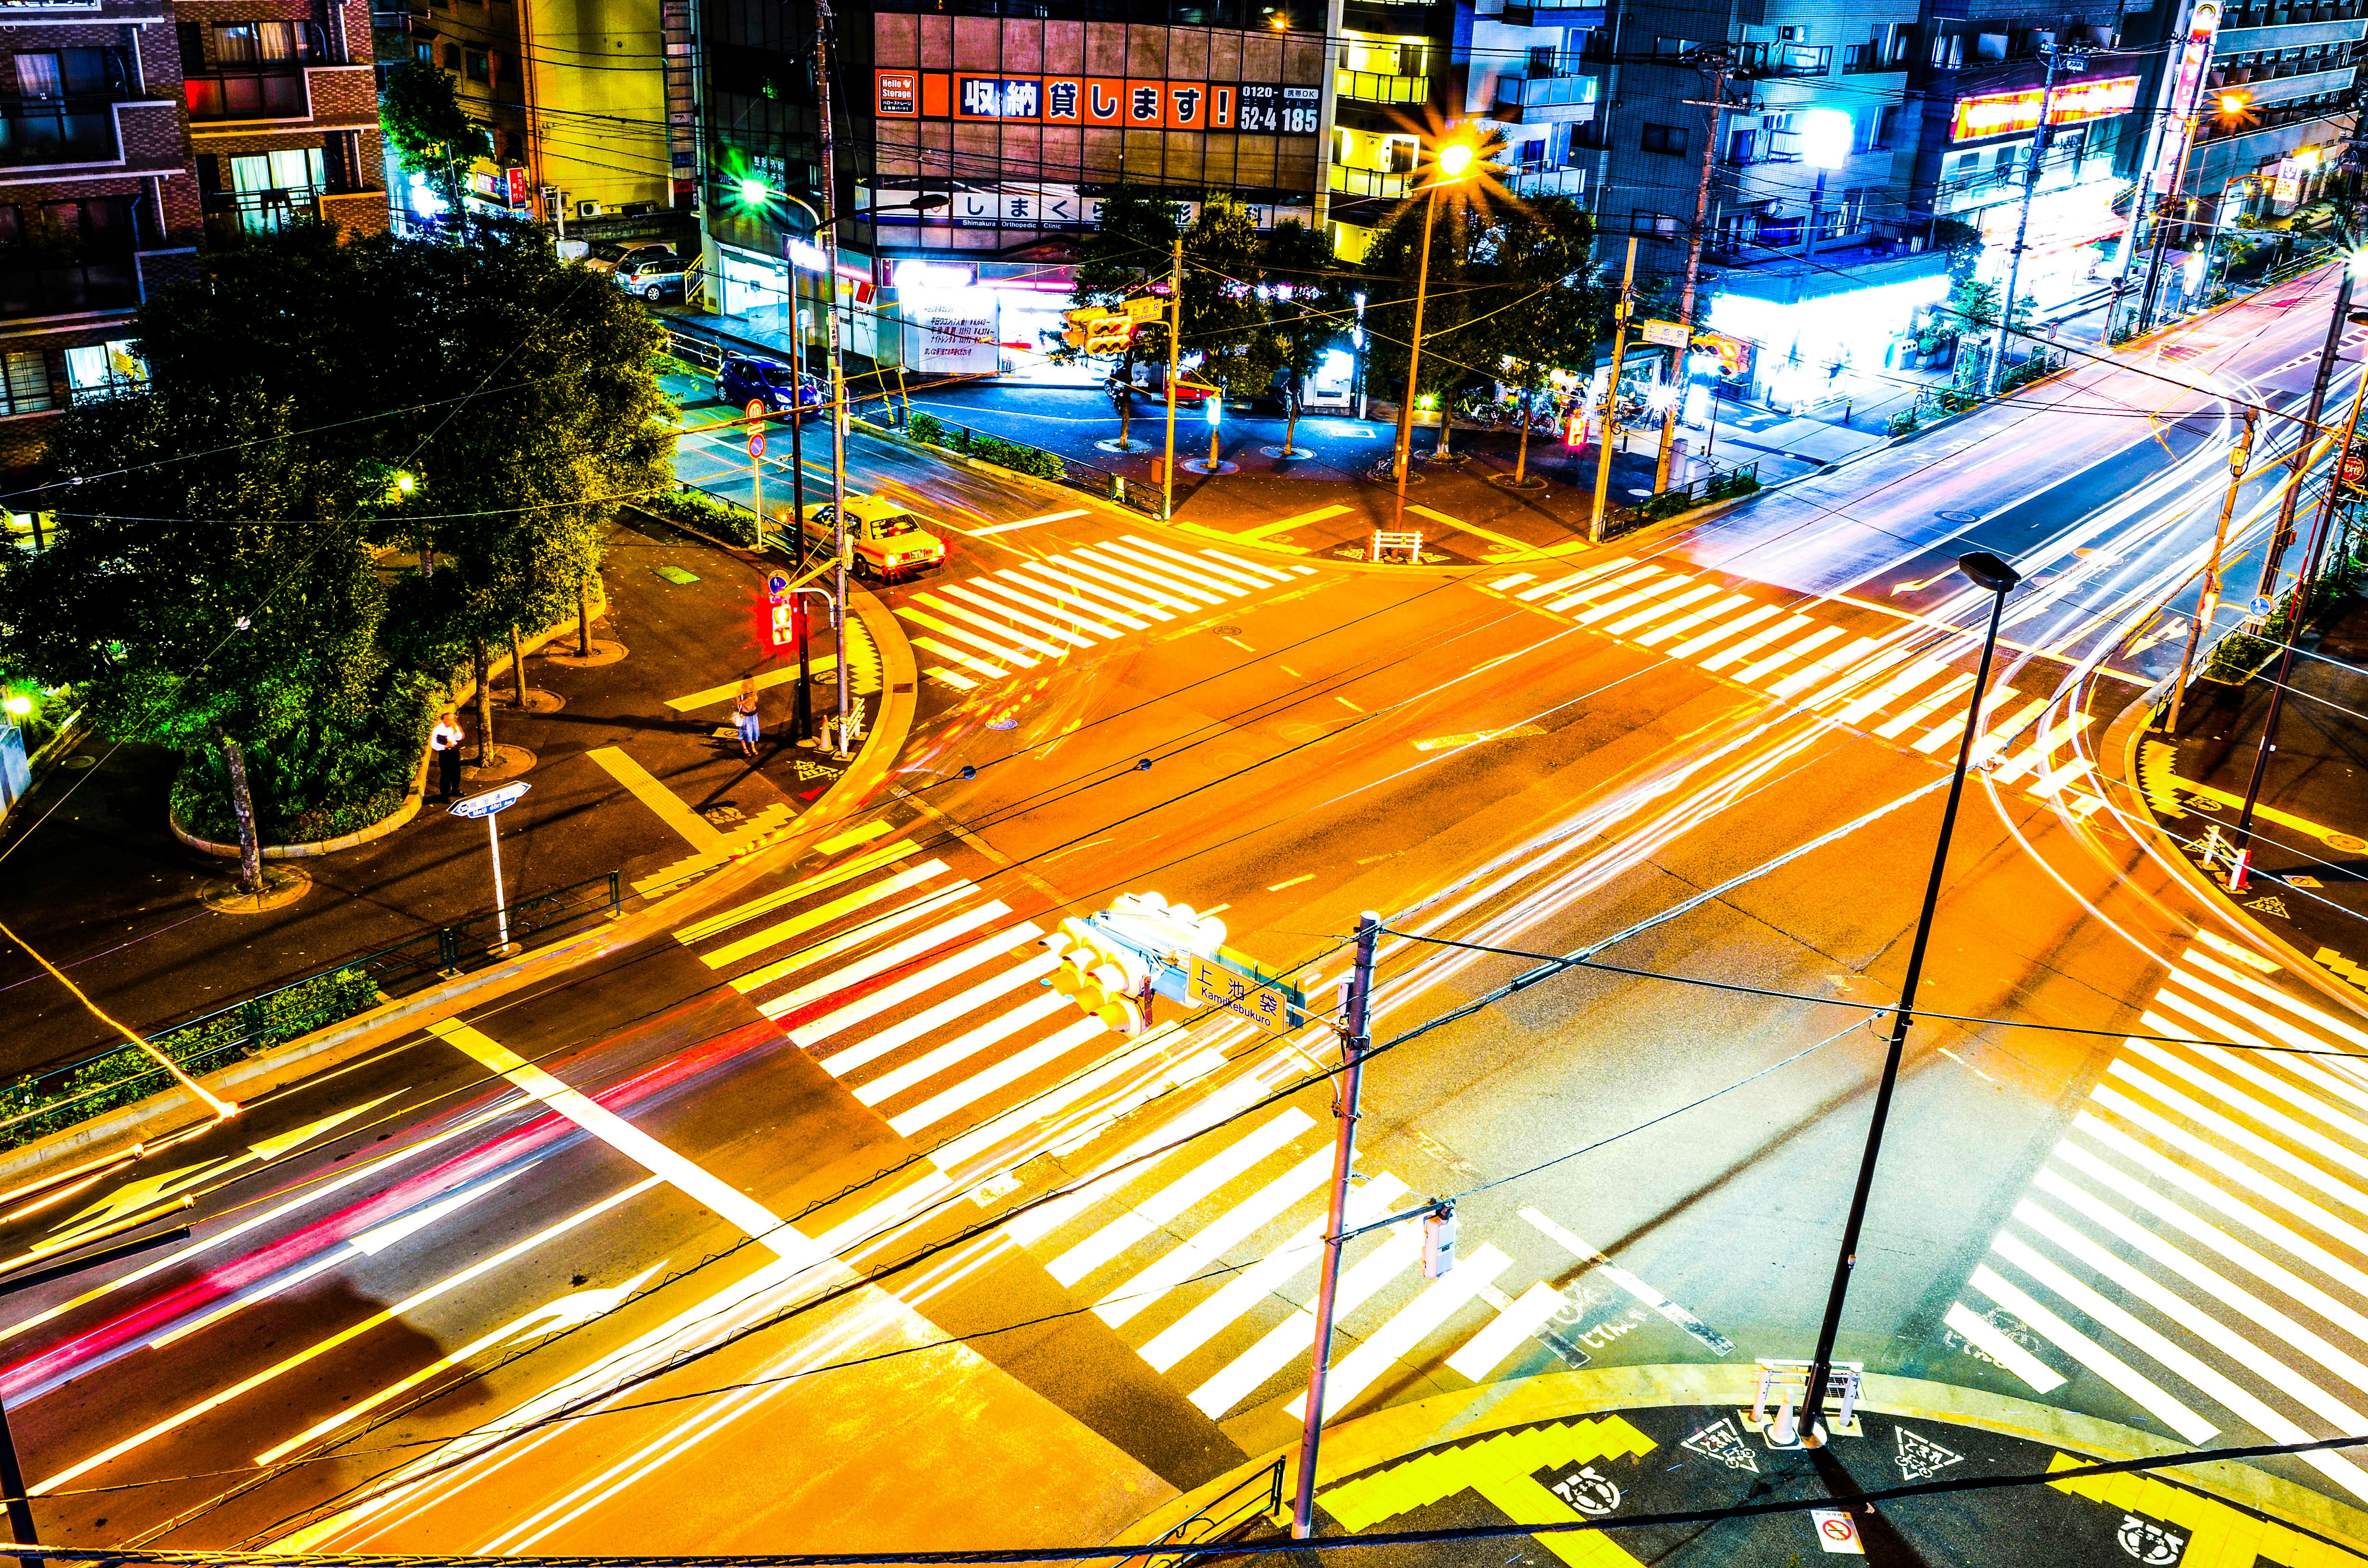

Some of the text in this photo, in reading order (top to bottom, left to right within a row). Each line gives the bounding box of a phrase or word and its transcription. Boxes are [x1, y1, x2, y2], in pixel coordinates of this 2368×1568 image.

[882, 79, 901, 88] Hello
[882, 88, 912, 98] Storage
[965, 80, 1230, 126] 収納貸します!
[754, 156, 784, 172] 整形外科
[1196, 964, 1277, 1017] 上池袋
[1201, 987, 1270, 1027] Kamiikebukuro
[1699, 1429, 1737, 1453] とまれ
[1905, 1438, 1943, 1465] とまれ
